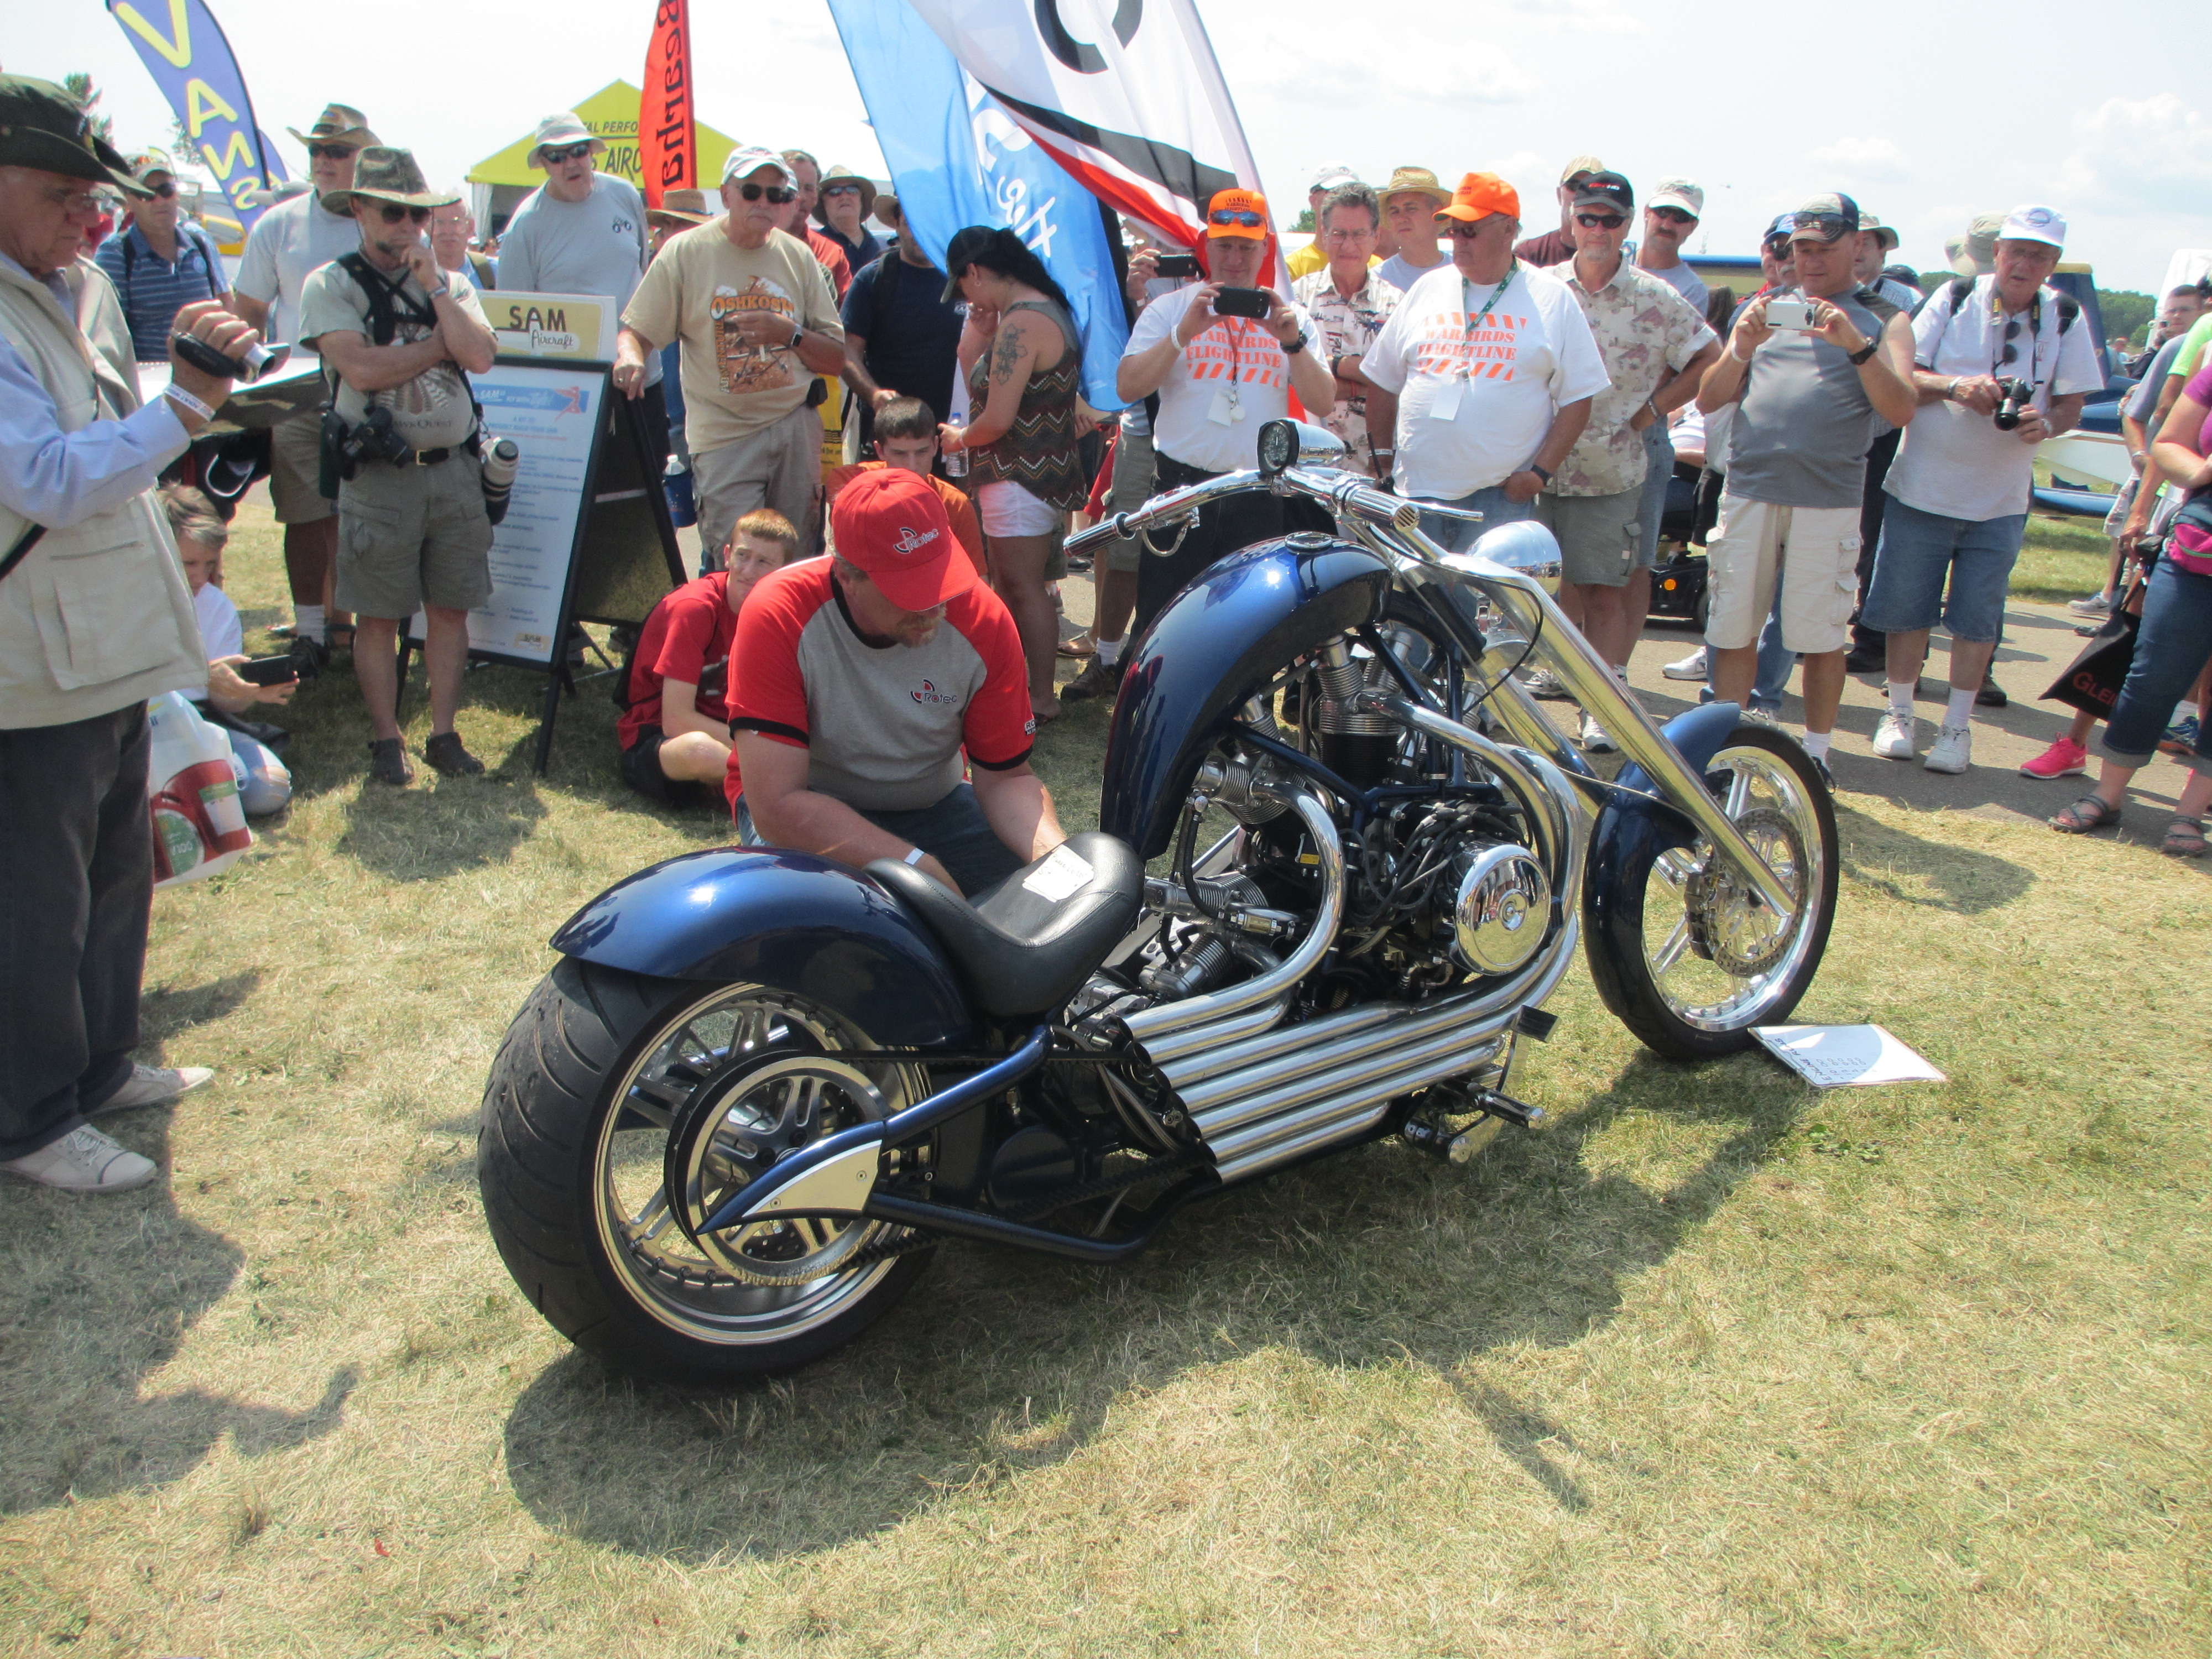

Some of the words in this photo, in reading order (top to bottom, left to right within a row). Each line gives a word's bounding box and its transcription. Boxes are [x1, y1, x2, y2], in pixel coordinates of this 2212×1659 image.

[711, 294, 795, 320] OSHKOSH
[509, 305, 567, 332] SAM
[531, 330, 574, 349] Aircraft
[1425, 328, 1516, 343] WARBIRDS
[1418, 342, 1518, 360] FLIGHTLINE
[907, 529, 939, 551] Rotec
[924, 692, 958, 704] Rotec
